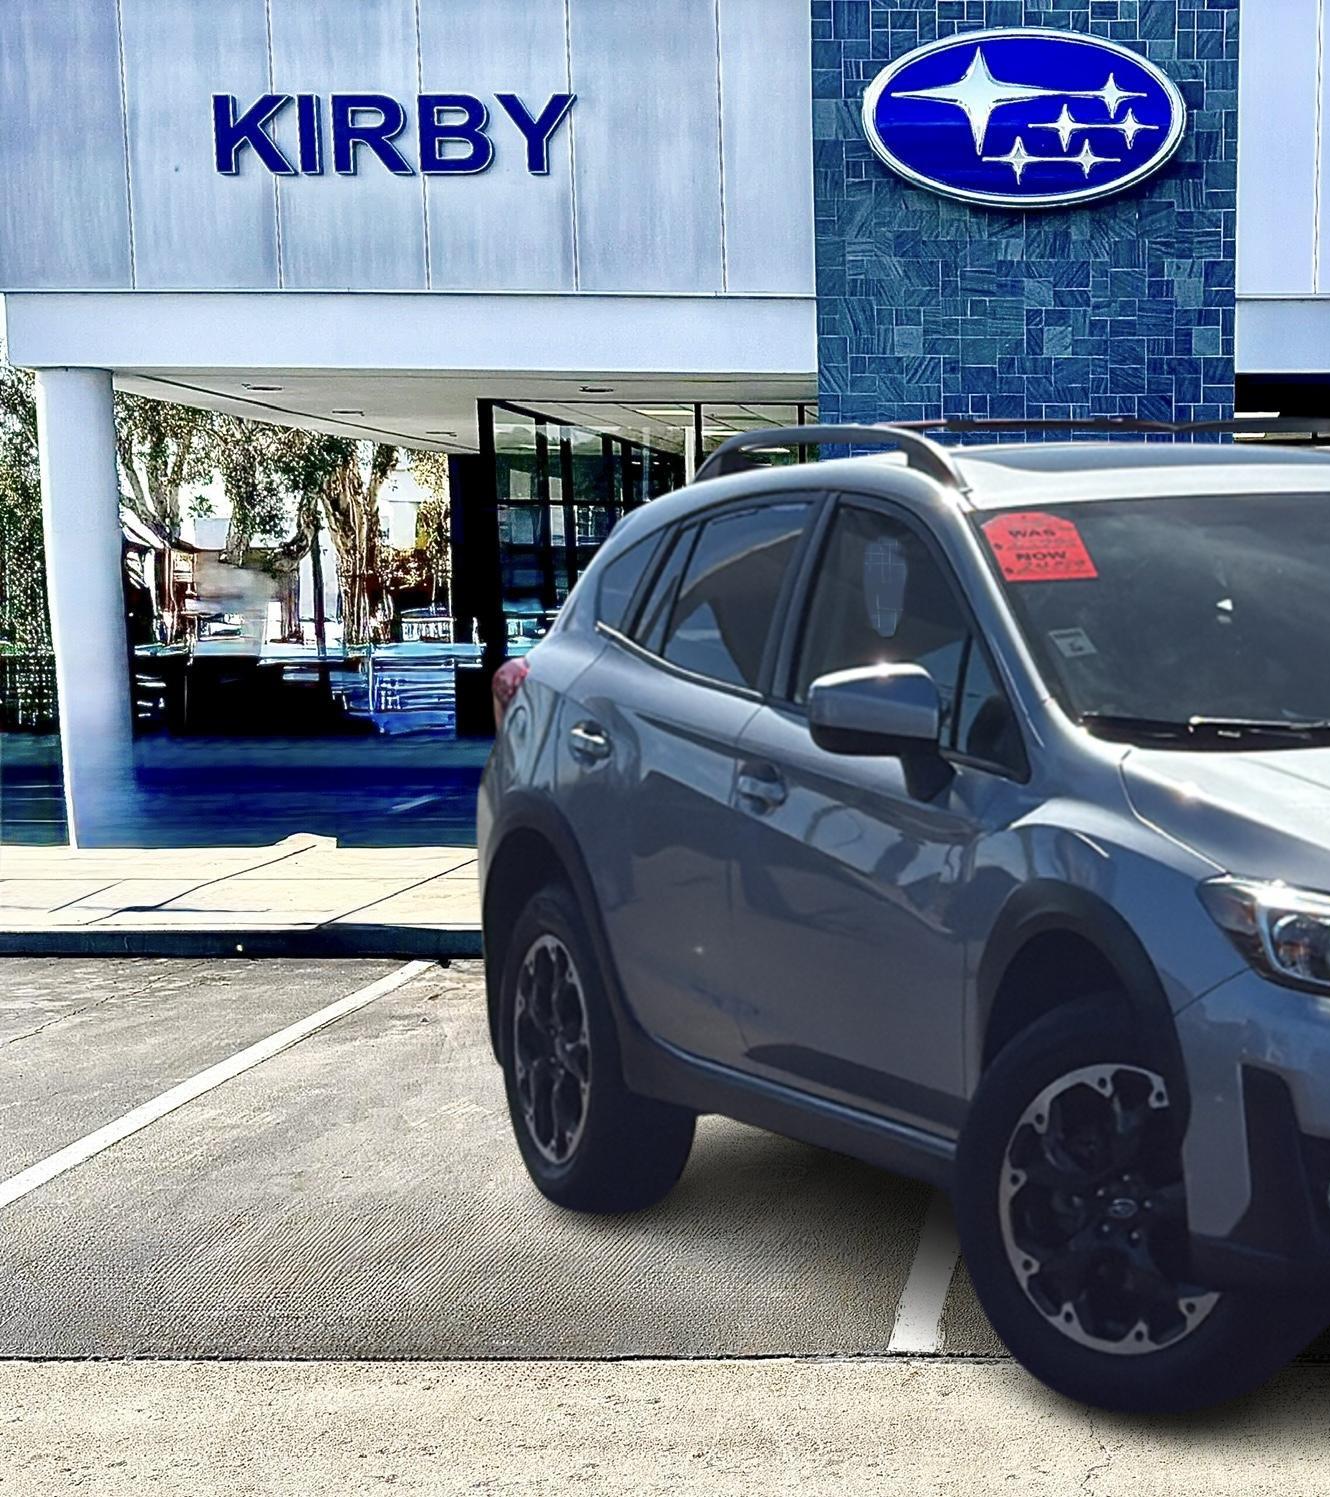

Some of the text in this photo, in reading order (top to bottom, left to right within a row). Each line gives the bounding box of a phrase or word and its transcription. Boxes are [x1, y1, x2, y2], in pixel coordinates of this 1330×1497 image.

[212, 92, 577, 176] KIRBY
[1008, 528, 1056, 539] WAS
[1015, 550, 1067, 562] NOW
